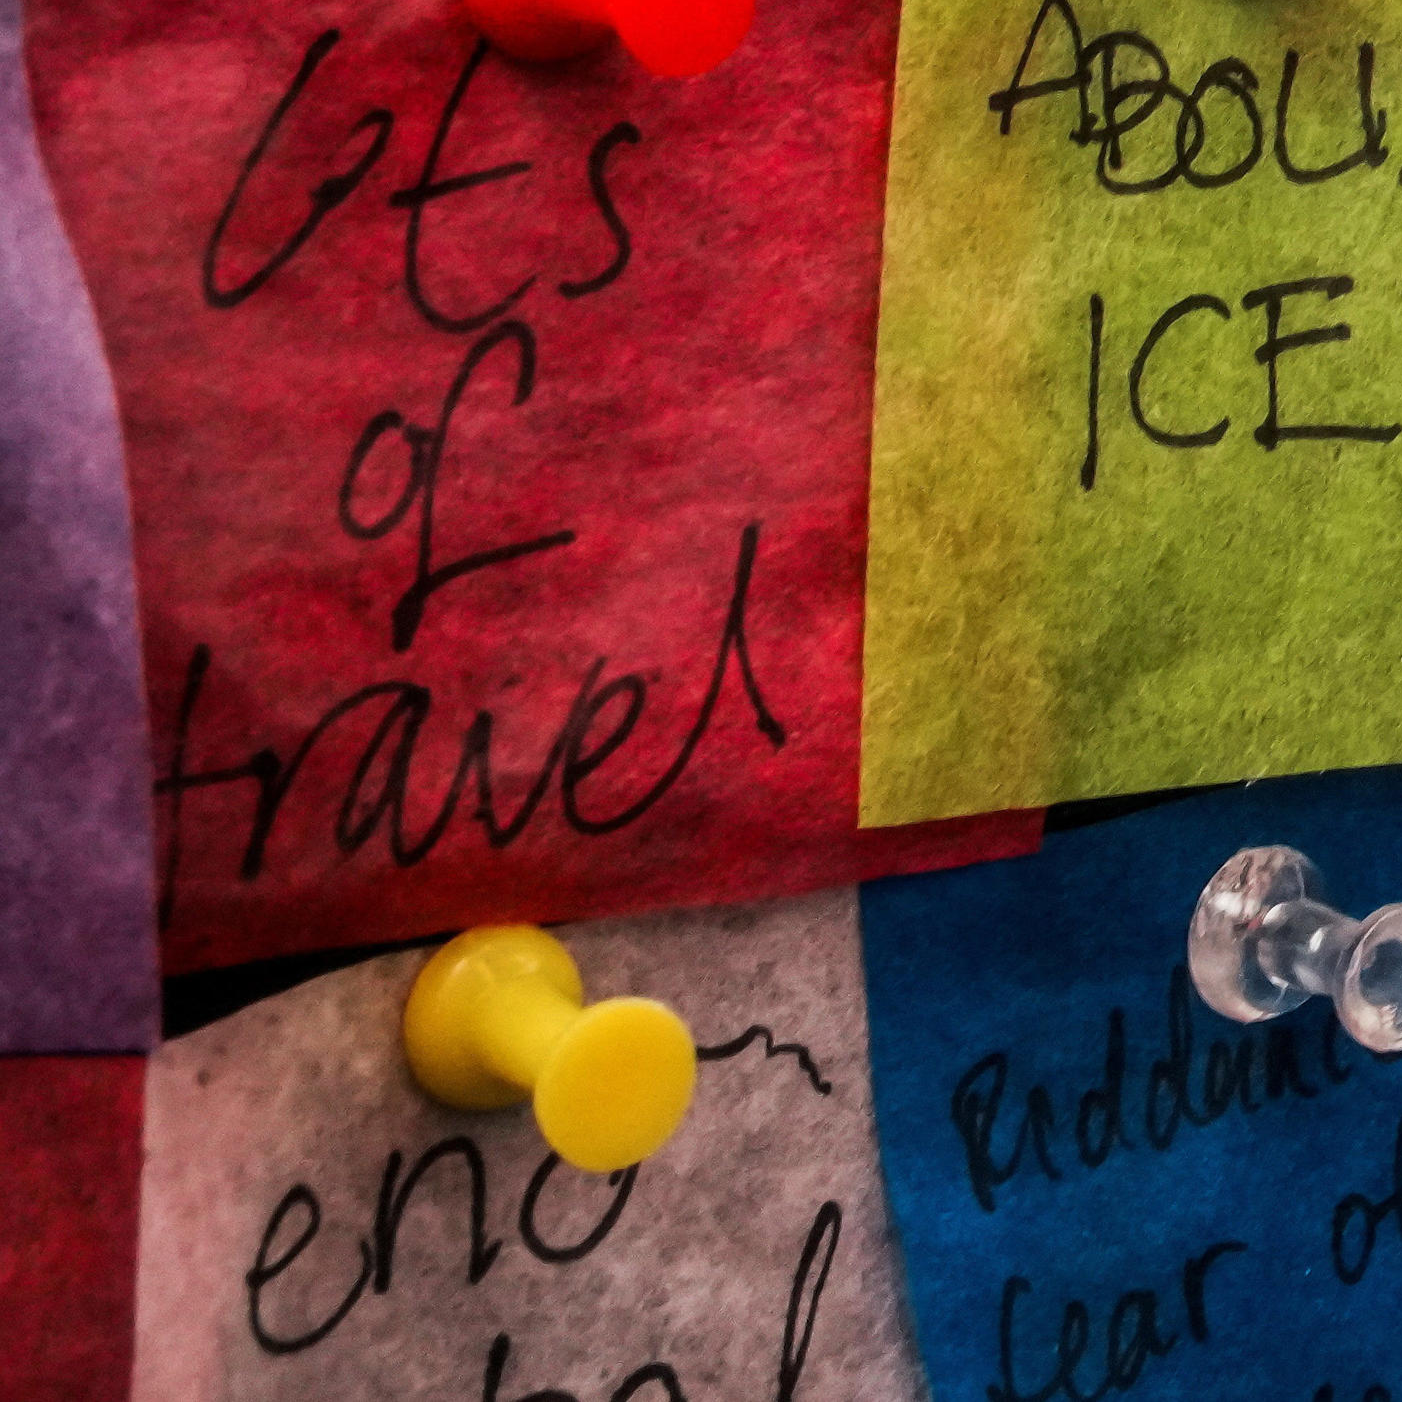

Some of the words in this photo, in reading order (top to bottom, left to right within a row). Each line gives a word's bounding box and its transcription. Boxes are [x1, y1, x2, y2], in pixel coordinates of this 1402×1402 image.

[337, 321, 576, 652] of
[1080, 275, 1402, 491] ICE
[154, 521, 785, 928] travel
